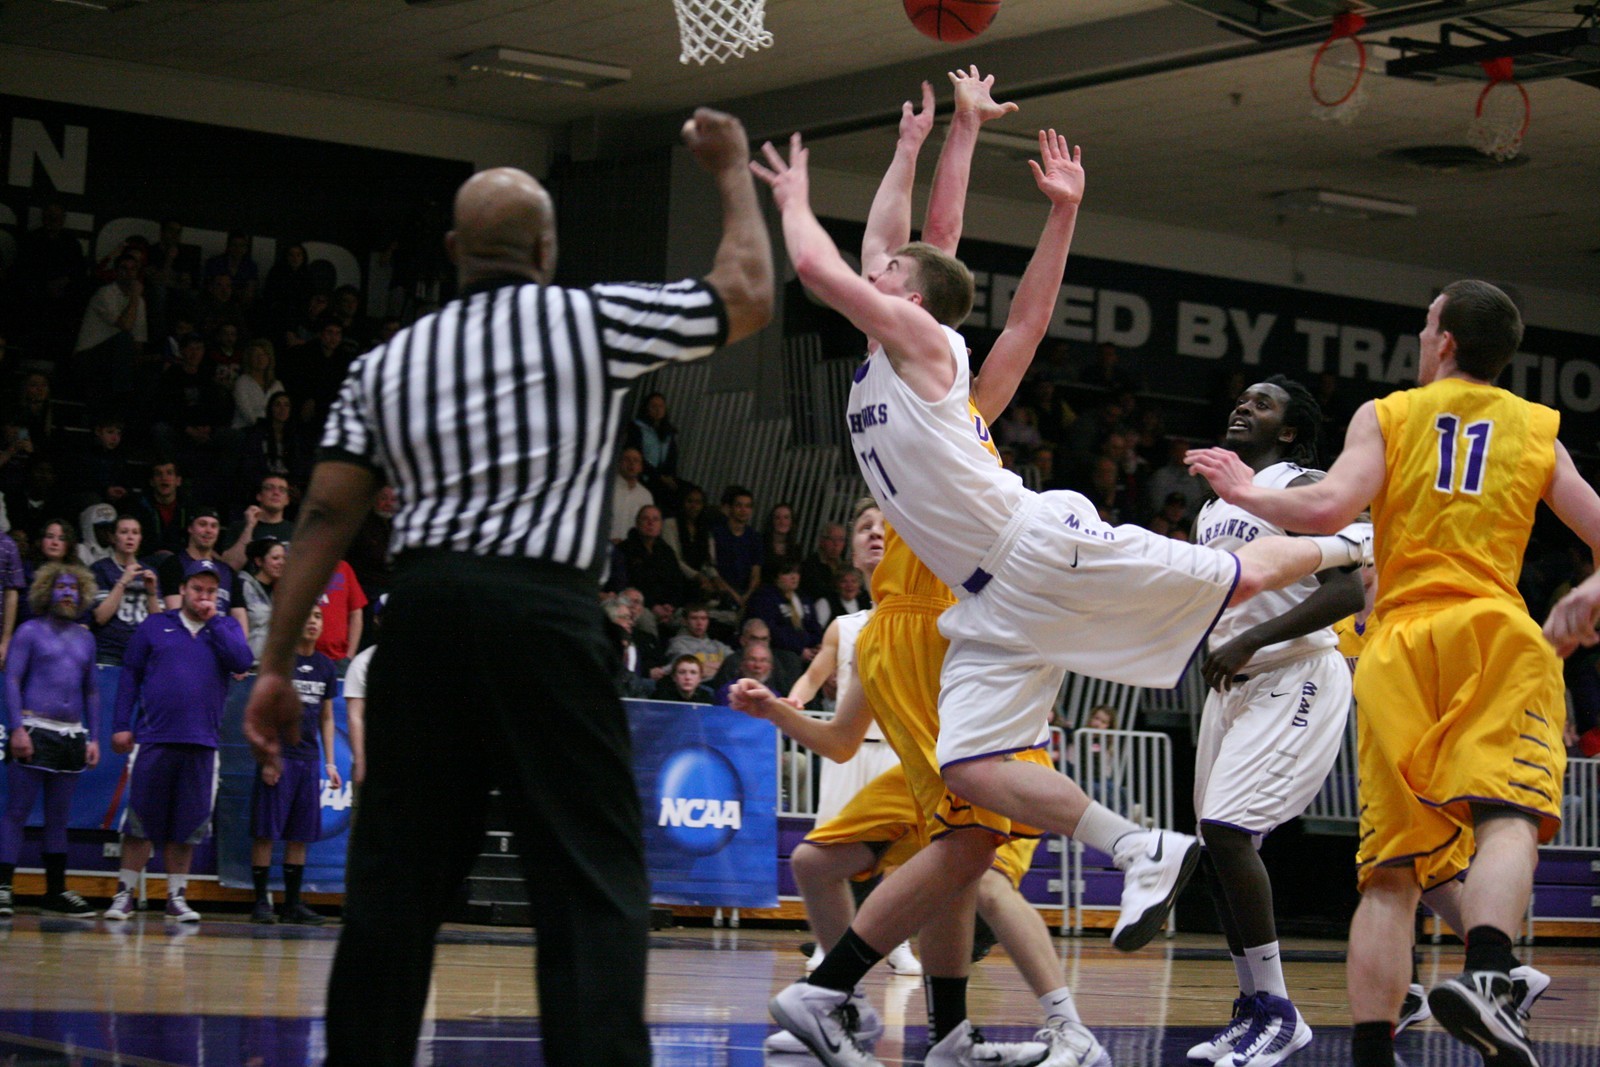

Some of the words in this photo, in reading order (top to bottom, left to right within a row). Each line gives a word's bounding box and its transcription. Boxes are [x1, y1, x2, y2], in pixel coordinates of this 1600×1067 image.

[7, 116, 89, 195] N
[1176, 300, 1278, 366] BY
[1433, 412, 1494, 495] 11
[1291, 681, 1318, 727] UWW
[658, 797, 742, 830] NCAA
